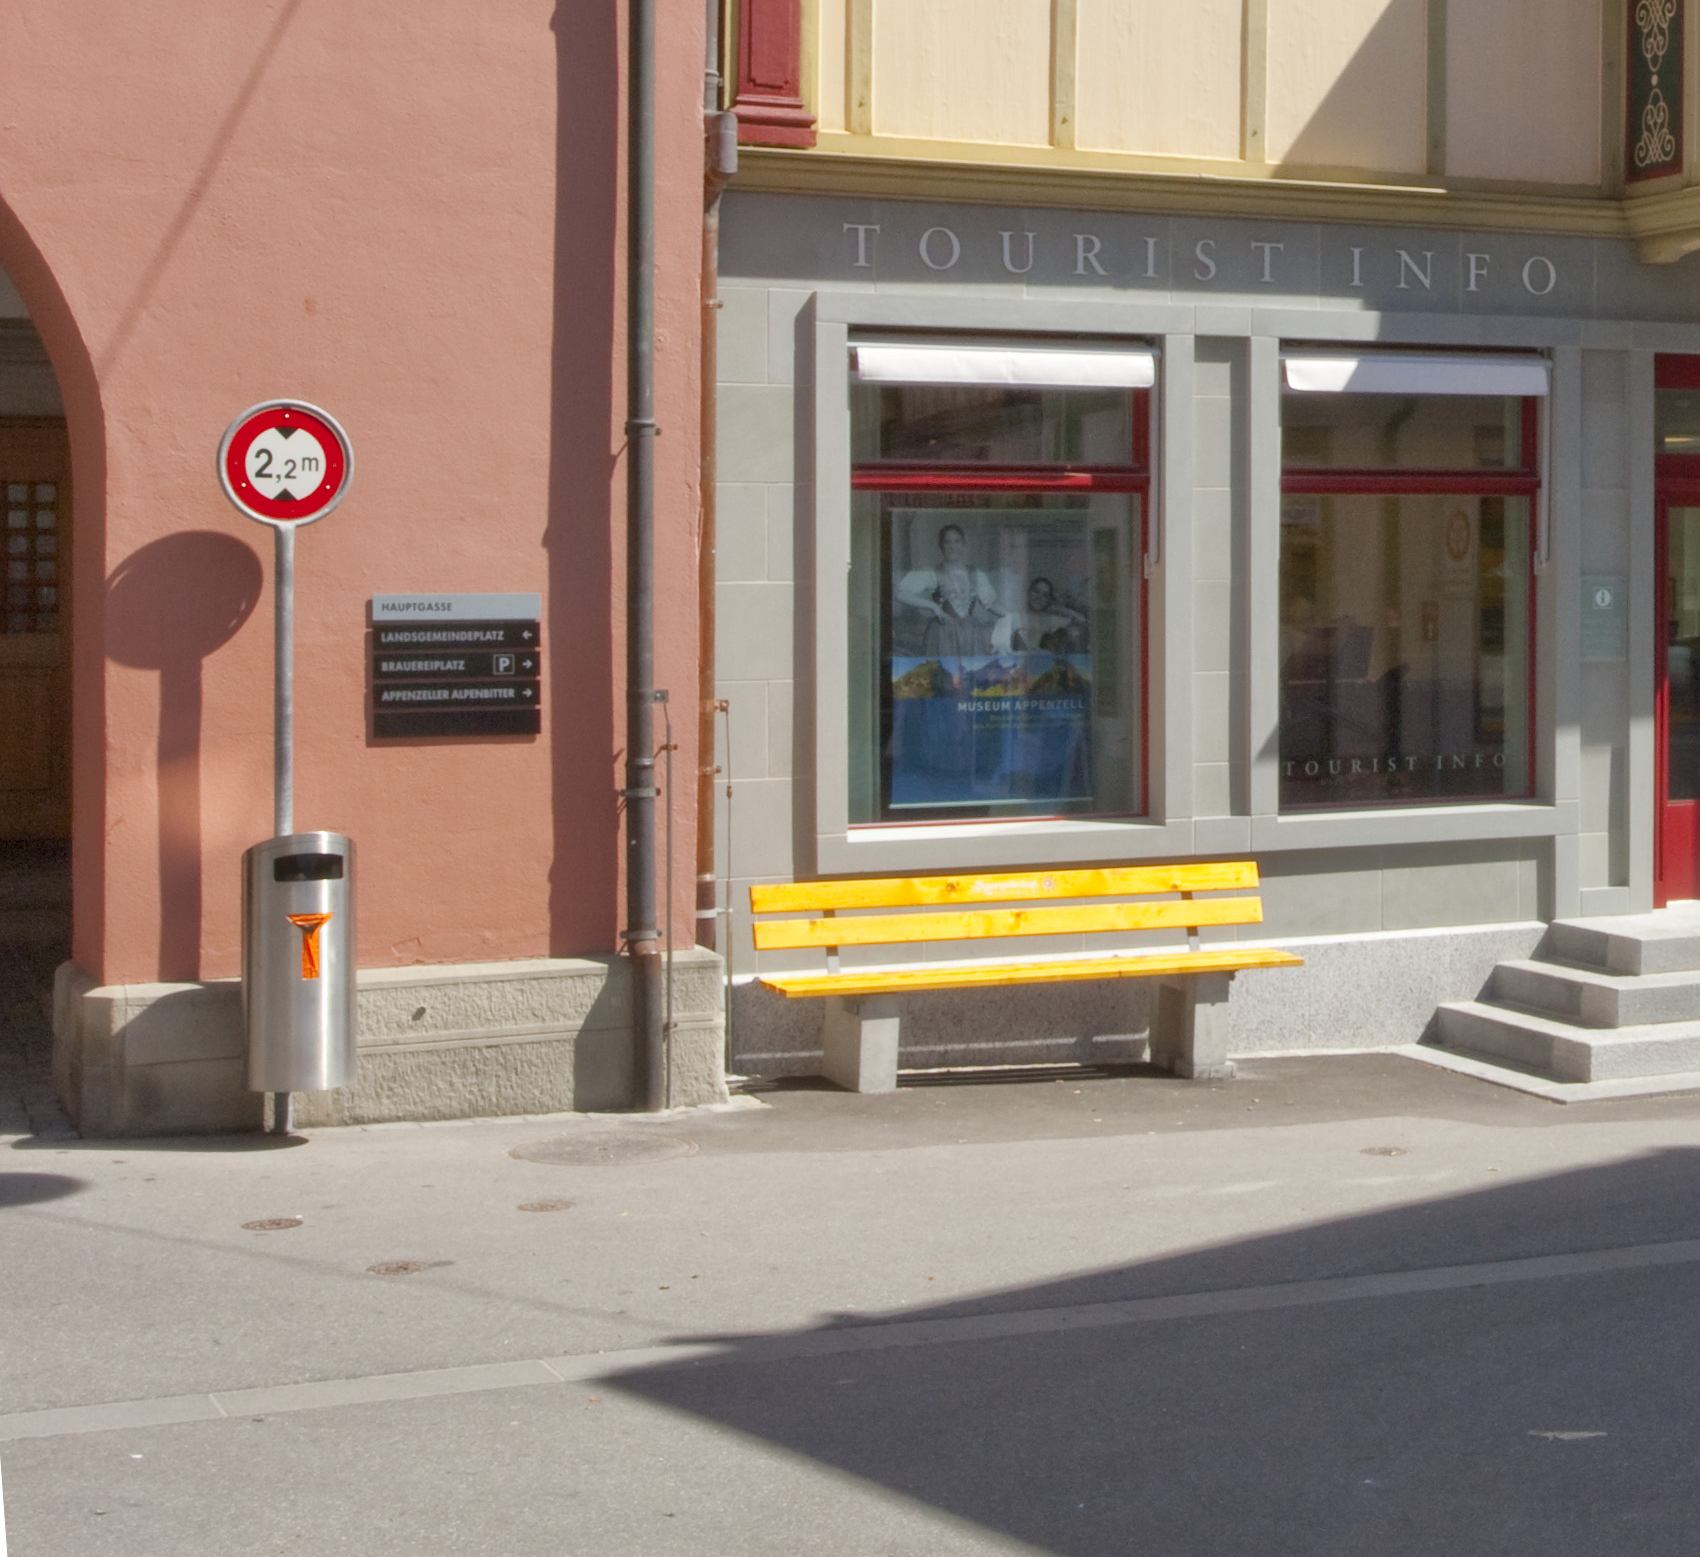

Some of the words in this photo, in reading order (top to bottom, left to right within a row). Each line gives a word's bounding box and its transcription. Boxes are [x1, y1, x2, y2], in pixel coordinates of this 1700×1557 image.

[843, 223, 1284, 282] TOURIST
[1348, 247, 1558, 295] INFO
[381, 602, 452, 612] HAUPTGASSE
[380, 631, 505, 643] LANDSGEMEINDEPLATZ
[381, 660, 465, 672] BRAUEREIPLATZ
[381, 689, 449, 701] APPENZELLER
[451, 688, 515, 700] ALPENBITTER
[957, 700, 1011, 712] MUSEUM
[1014, 698, 1085, 711] APPENZELL
[1282, 755, 1418, 777] TOURIST
[1435, 752, 1507, 770] INFO
